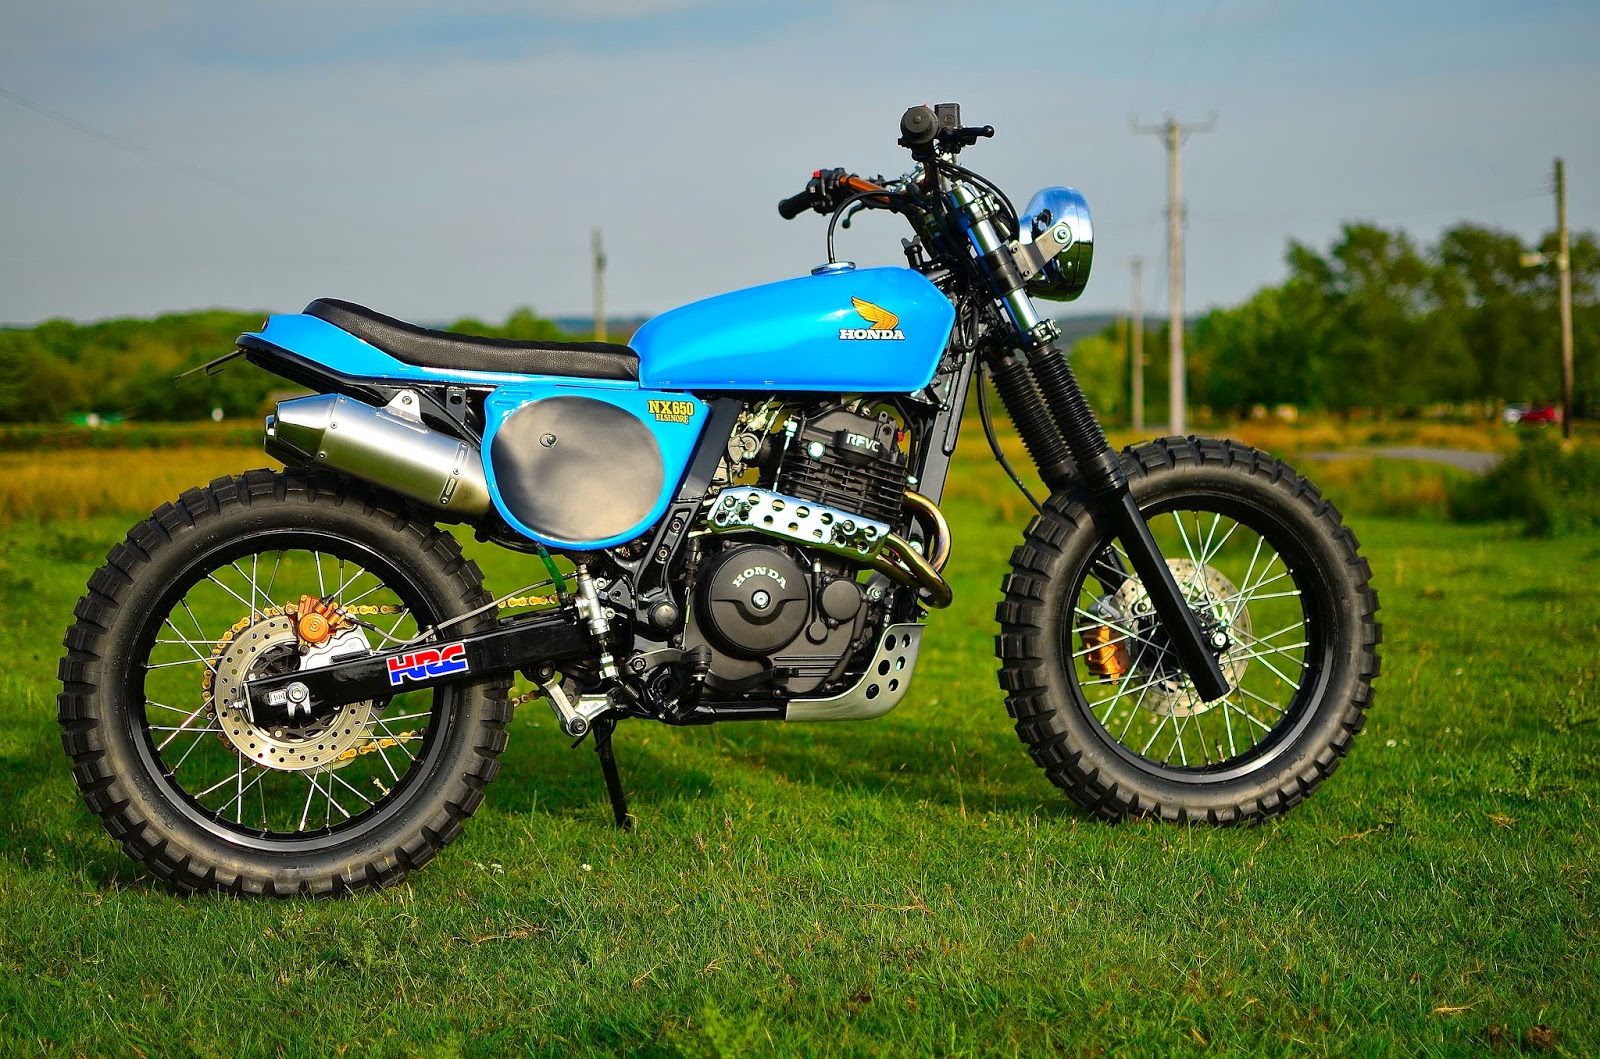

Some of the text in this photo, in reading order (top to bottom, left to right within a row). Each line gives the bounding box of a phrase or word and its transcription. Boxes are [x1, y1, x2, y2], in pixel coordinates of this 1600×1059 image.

[839, 329, 906, 340] HONDA
[647, 400, 694, 416] NX650
[655, 413, 689, 425] ELSINORE
[846, 433, 880, 452] RFVC
[732, 566, 787, 589] HONDA
[386, 642, 469, 686] HRC
